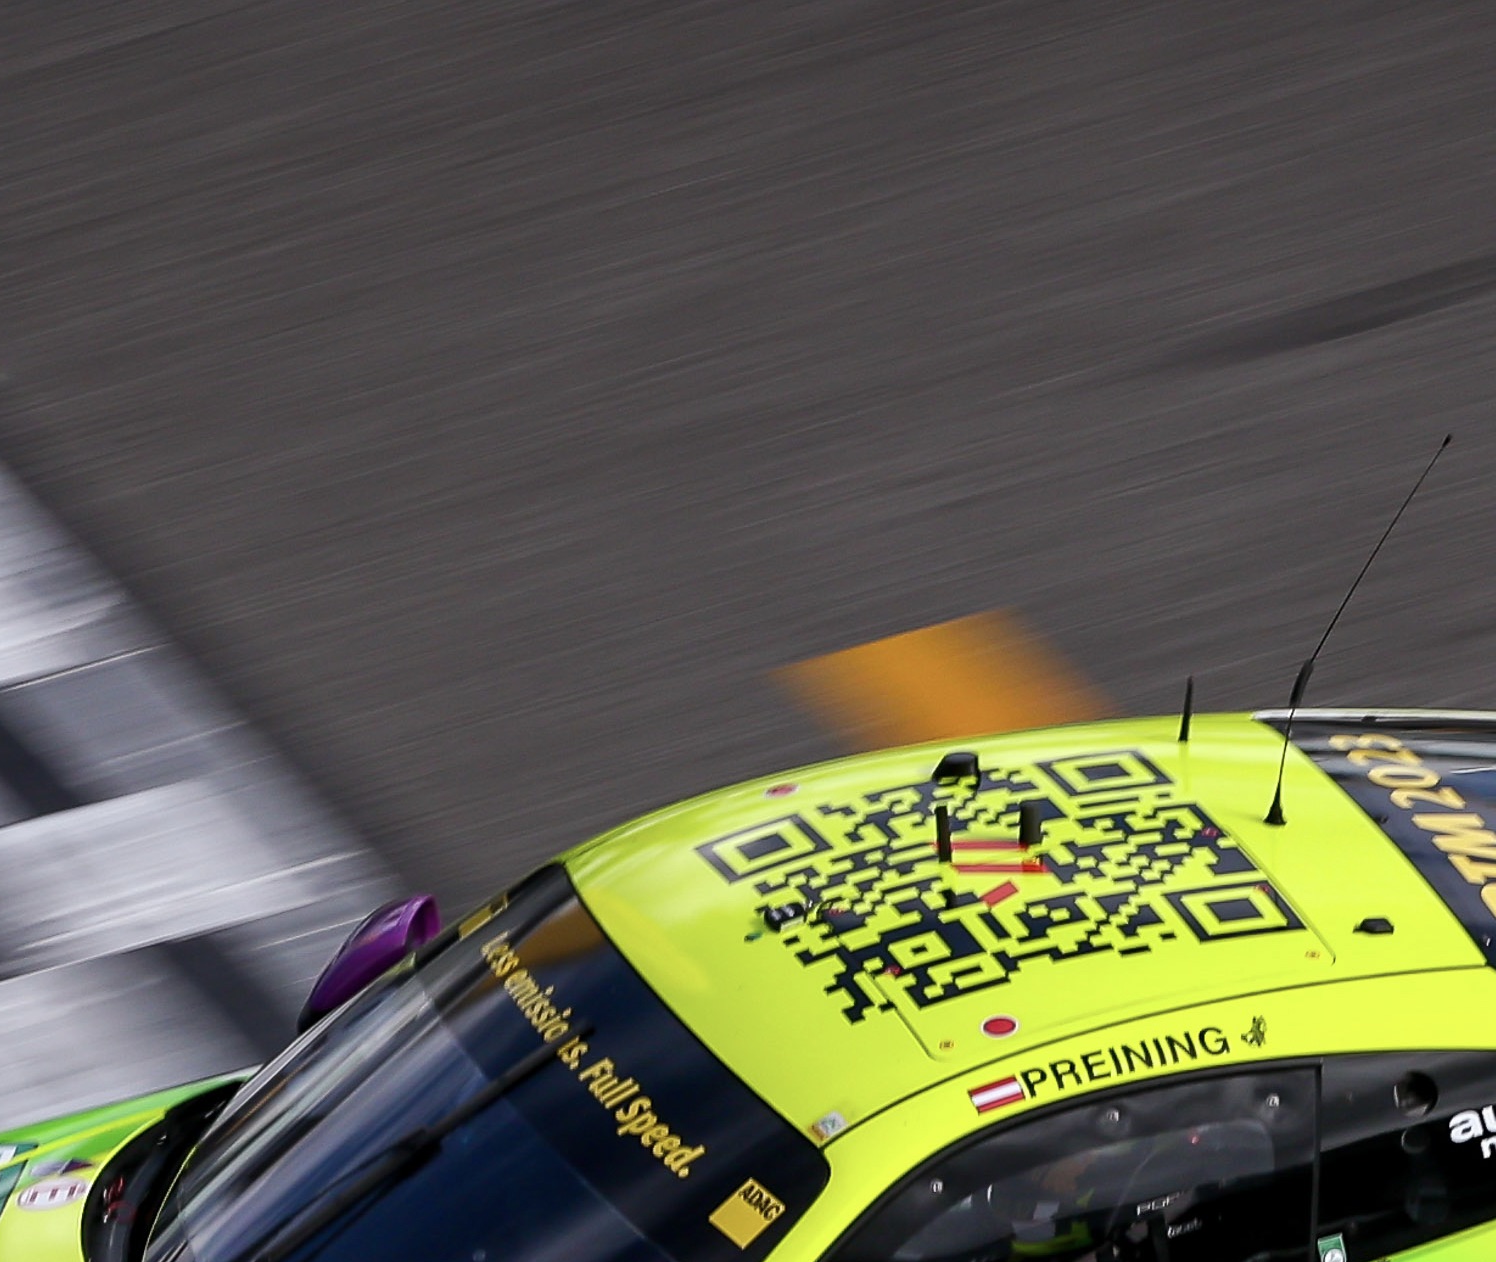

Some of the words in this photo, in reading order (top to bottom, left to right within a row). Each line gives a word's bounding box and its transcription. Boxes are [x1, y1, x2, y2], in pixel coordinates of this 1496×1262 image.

[1328, 732, 1467, 810] 2023
[1019, 1026, 1231, 1098] PREINING
[578, 1056, 640, 1109] Full
[615, 1095, 705, 1178] Speed.
[739, 1183, 784, 1222] ADAC
